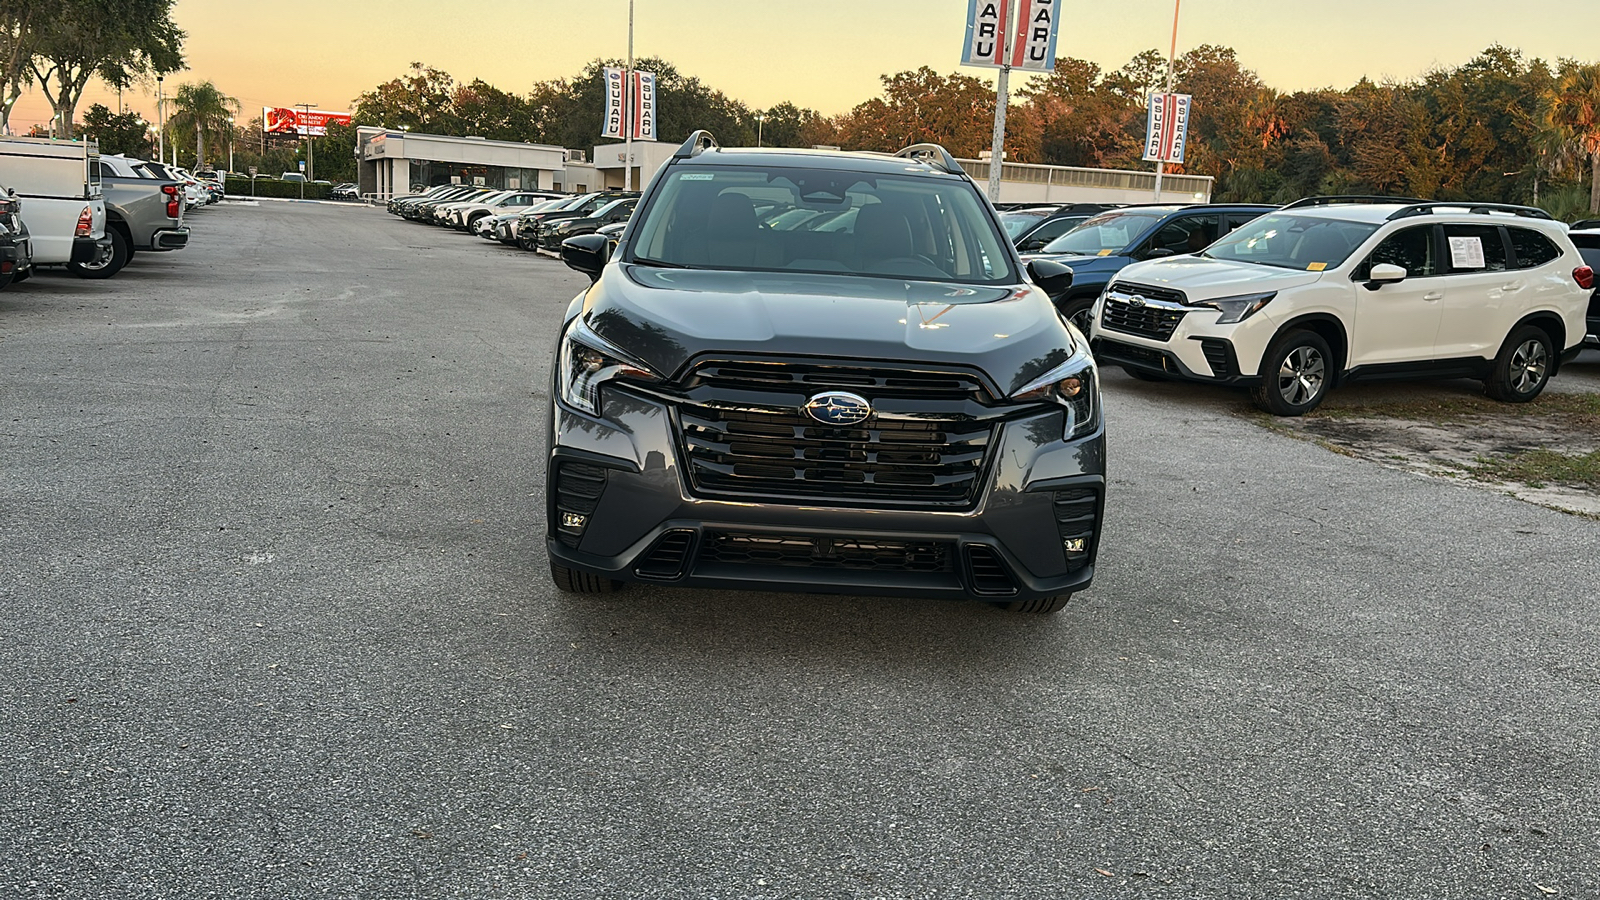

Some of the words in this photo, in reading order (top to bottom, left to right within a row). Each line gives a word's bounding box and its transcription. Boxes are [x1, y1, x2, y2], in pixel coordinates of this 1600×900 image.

[1030, 0, 1051, 61] ARU
[610, 82, 620, 133] SUBARU
[642, 85, 651, 135] SUBARU
[1149, 105, 1162, 156] SUBARU
[1172, 107, 1185, 158] SUBARU
